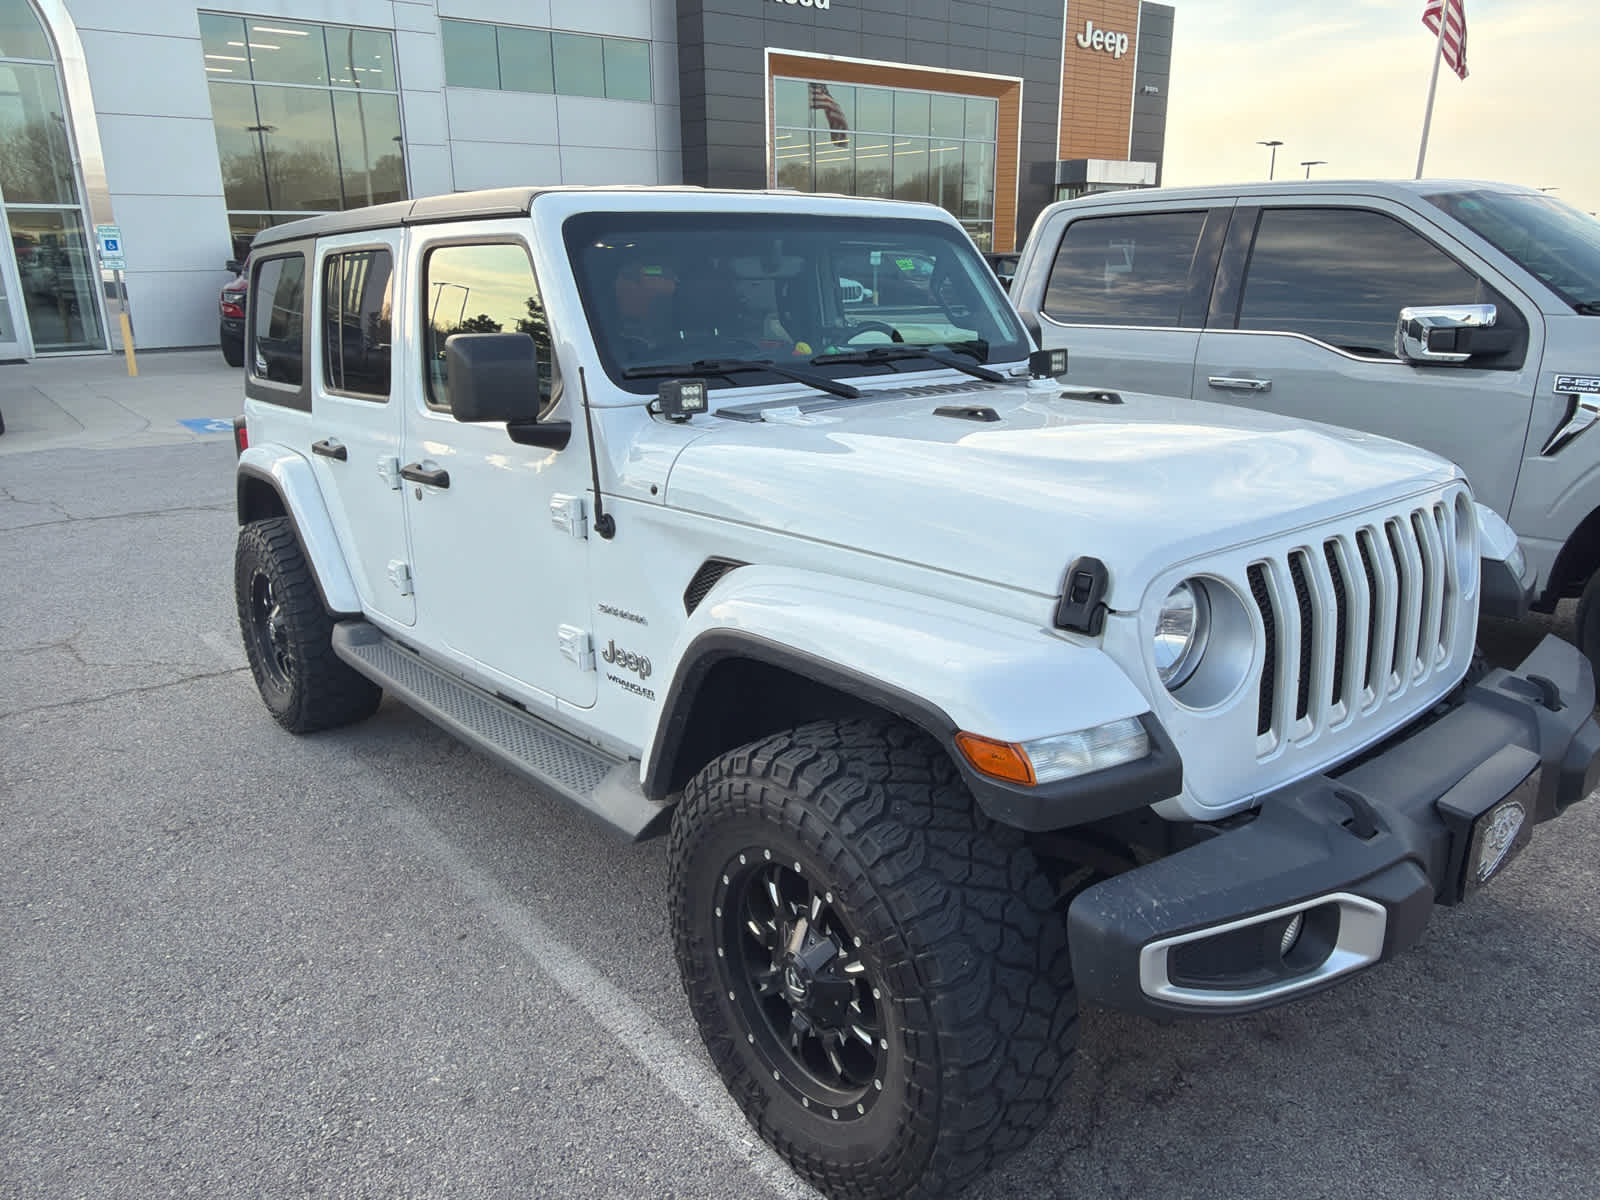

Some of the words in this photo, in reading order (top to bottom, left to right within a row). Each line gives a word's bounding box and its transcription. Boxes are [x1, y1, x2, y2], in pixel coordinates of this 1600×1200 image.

[1077, 20, 1128, 58] Jeep
[1558, 377, 1600, 387] F-150
[601, 639, 652, 680] Jeep
